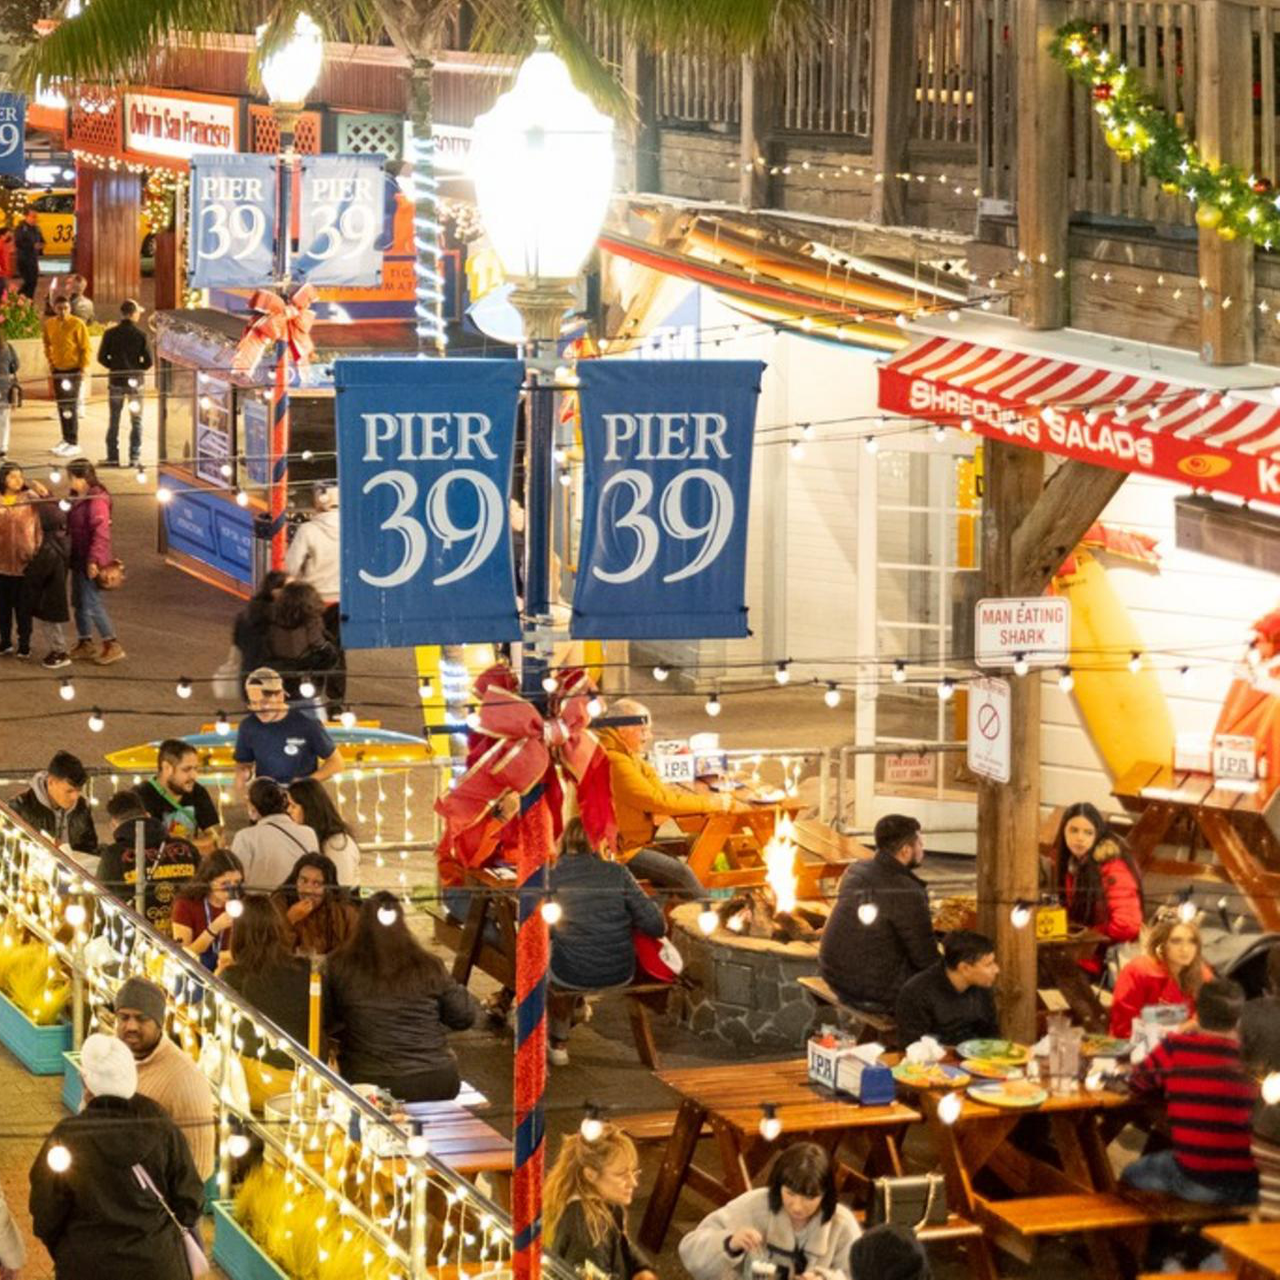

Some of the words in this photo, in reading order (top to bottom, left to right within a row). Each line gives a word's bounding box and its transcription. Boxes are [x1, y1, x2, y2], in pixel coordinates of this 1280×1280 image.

[130, 102, 152, 135] Only
[153, 106, 162, 138] in
[164, 109, 182, 142] San
[183, 110, 231, 149] Francisco
[200, 176, 265, 202] PIER
[311, 177, 374, 202] PIER
[53, 225, 75, 242] 33
[198, 204, 266, 260] 39
[306, 204, 375, 260] 39
[360, 412, 498, 462] PIER
[601, 412, 732, 462] PIER
[909, 380, 1041, 444] SHREDDING
[1047, 414, 1155, 468] SALADS
[358, 468, 504, 588] 39
[592, 468, 734, 584] 39
[982, 609, 1013, 625] MAN
[1016, 607, 1064, 624] EATING
[1000, 629, 1046, 646] SHARK
[1219, 756, 1249, 773] IPA
[812, 1051, 833, 1080] IPA
